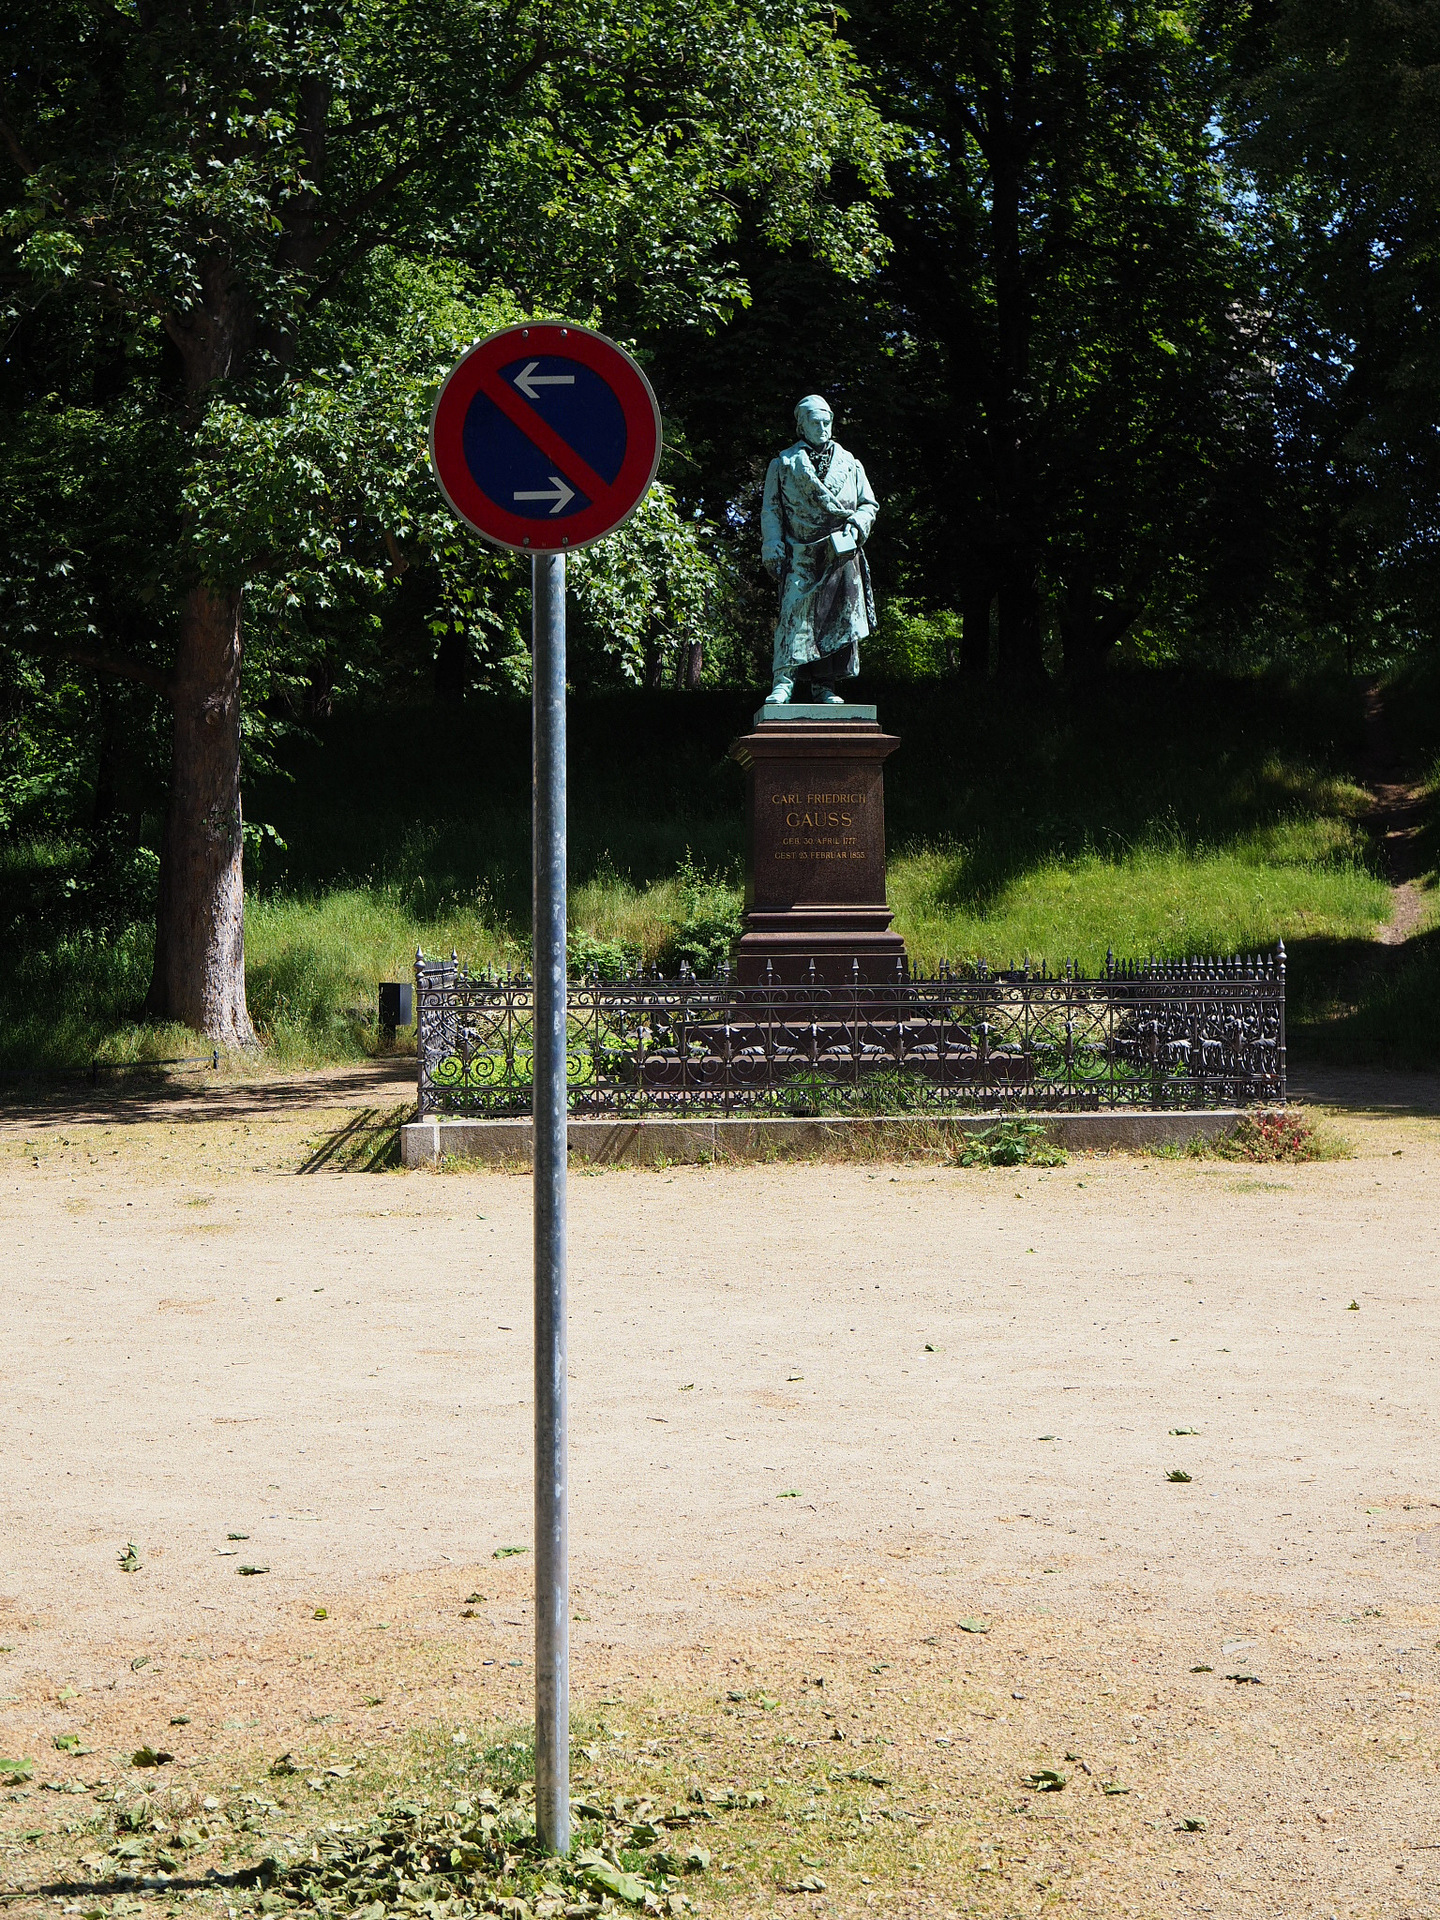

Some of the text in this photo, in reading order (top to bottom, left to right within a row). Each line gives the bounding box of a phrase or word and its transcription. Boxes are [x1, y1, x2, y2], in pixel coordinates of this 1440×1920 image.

[772, 794, 866, 804] CARL FRIEDRICH
[786, 812, 852, 827] GAUSS
[817, 837, 840, 845] APRIL
[810, 851, 847, 860] FEBRUAR
